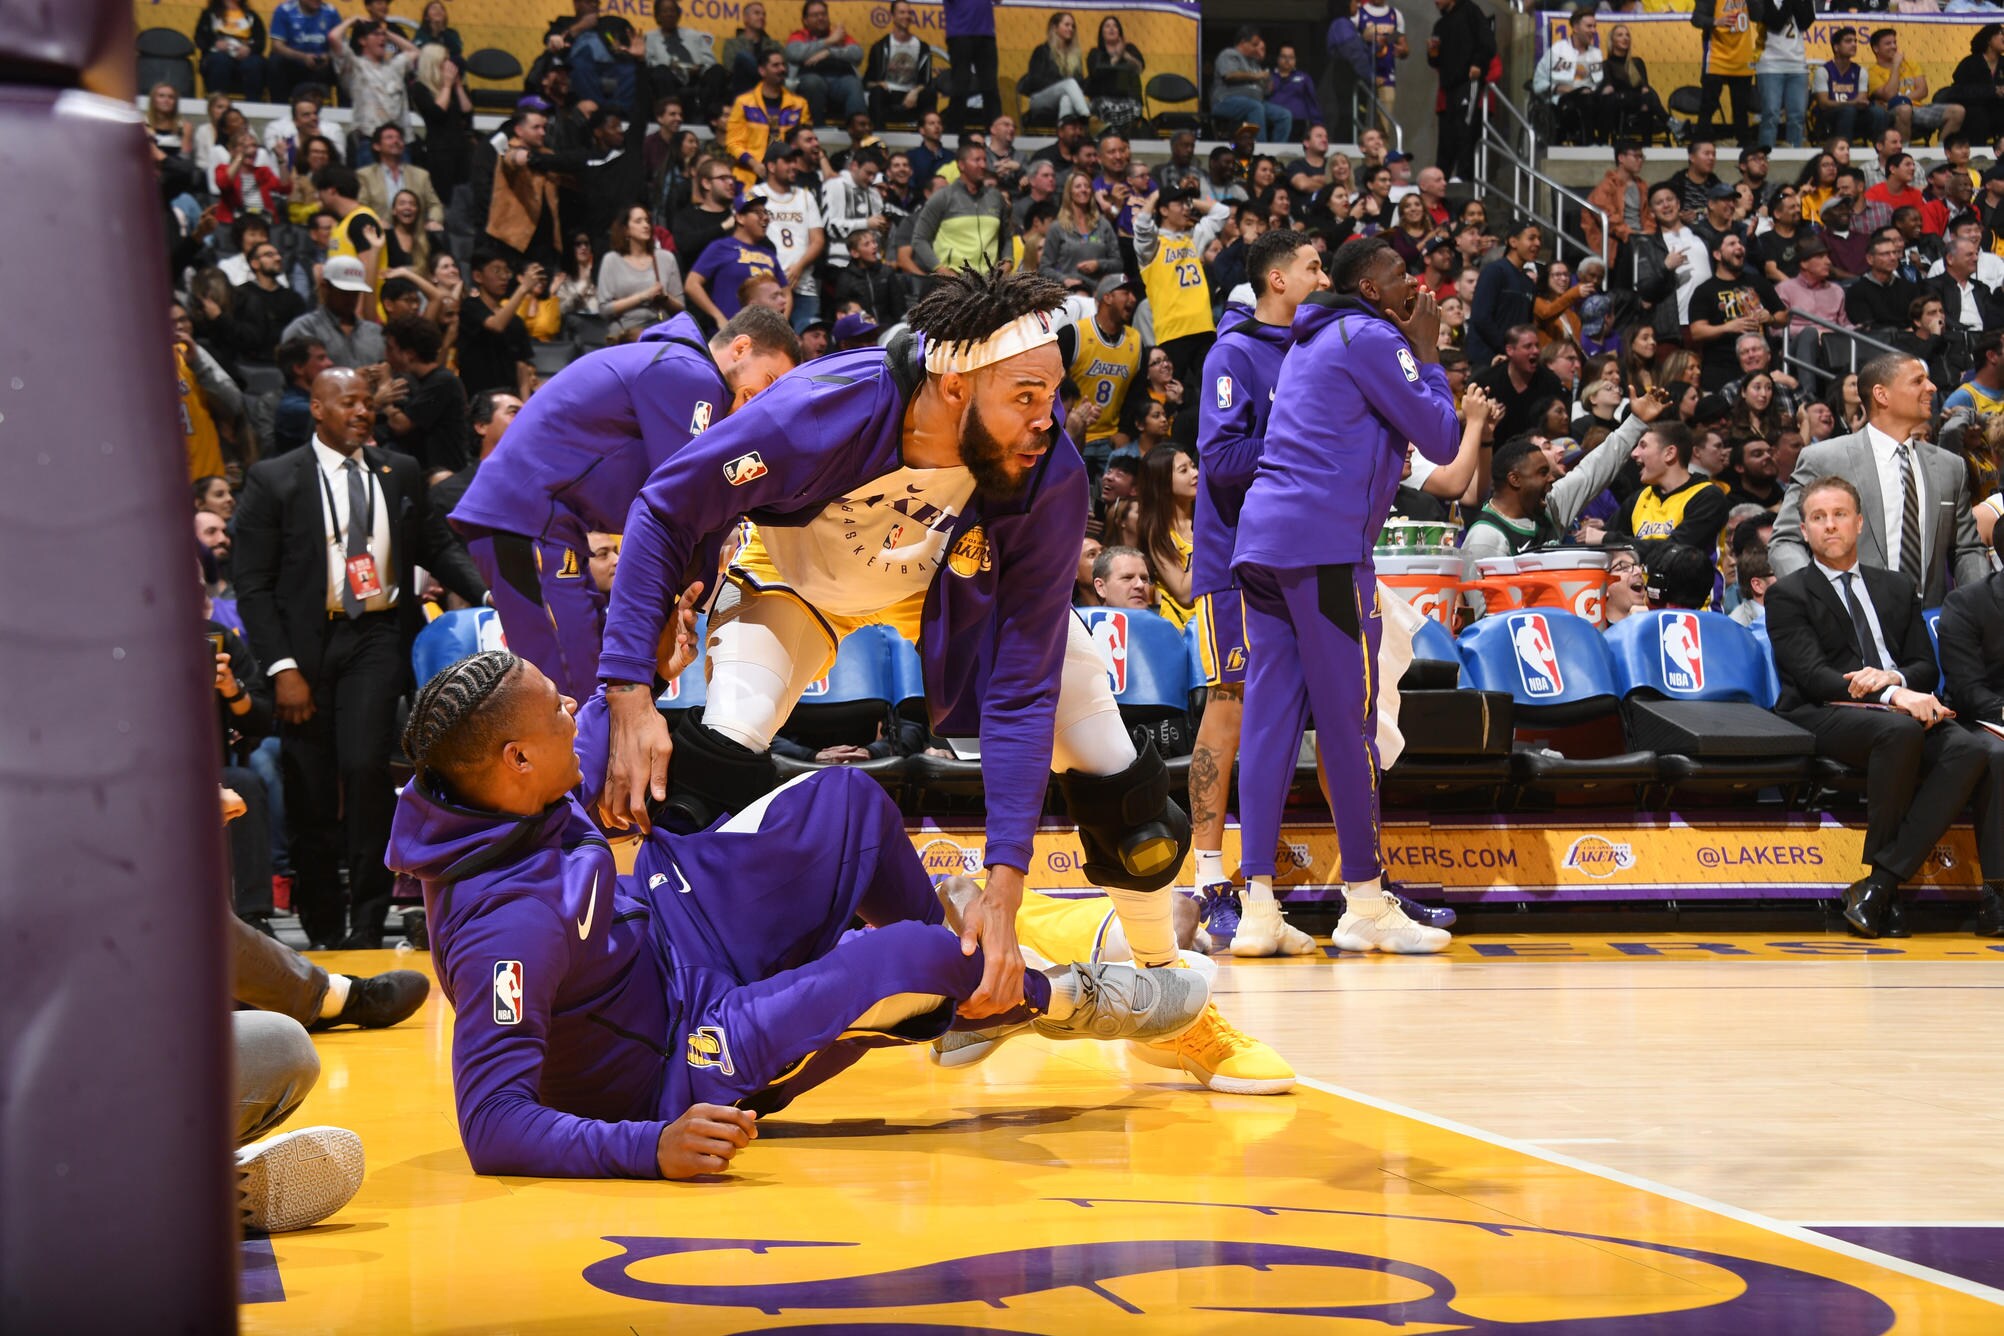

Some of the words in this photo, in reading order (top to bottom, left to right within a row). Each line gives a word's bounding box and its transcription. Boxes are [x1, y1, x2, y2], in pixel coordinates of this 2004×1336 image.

[781, 228, 794, 248] 8
[1175, 263, 1202, 288] 23
[1085, 358, 1129, 380] LAKERS
[1095, 379, 1114, 405] 8
[1575, 588, 1603, 624] G
[1528, 677, 1549, 692] NBA
[1669, 672, 1689, 687] NBA
[1568, 846, 1630, 867] LAKERS
[1696, 846, 1825, 868] @LAKERS
[497, 1009, 512, 1021] NBA
